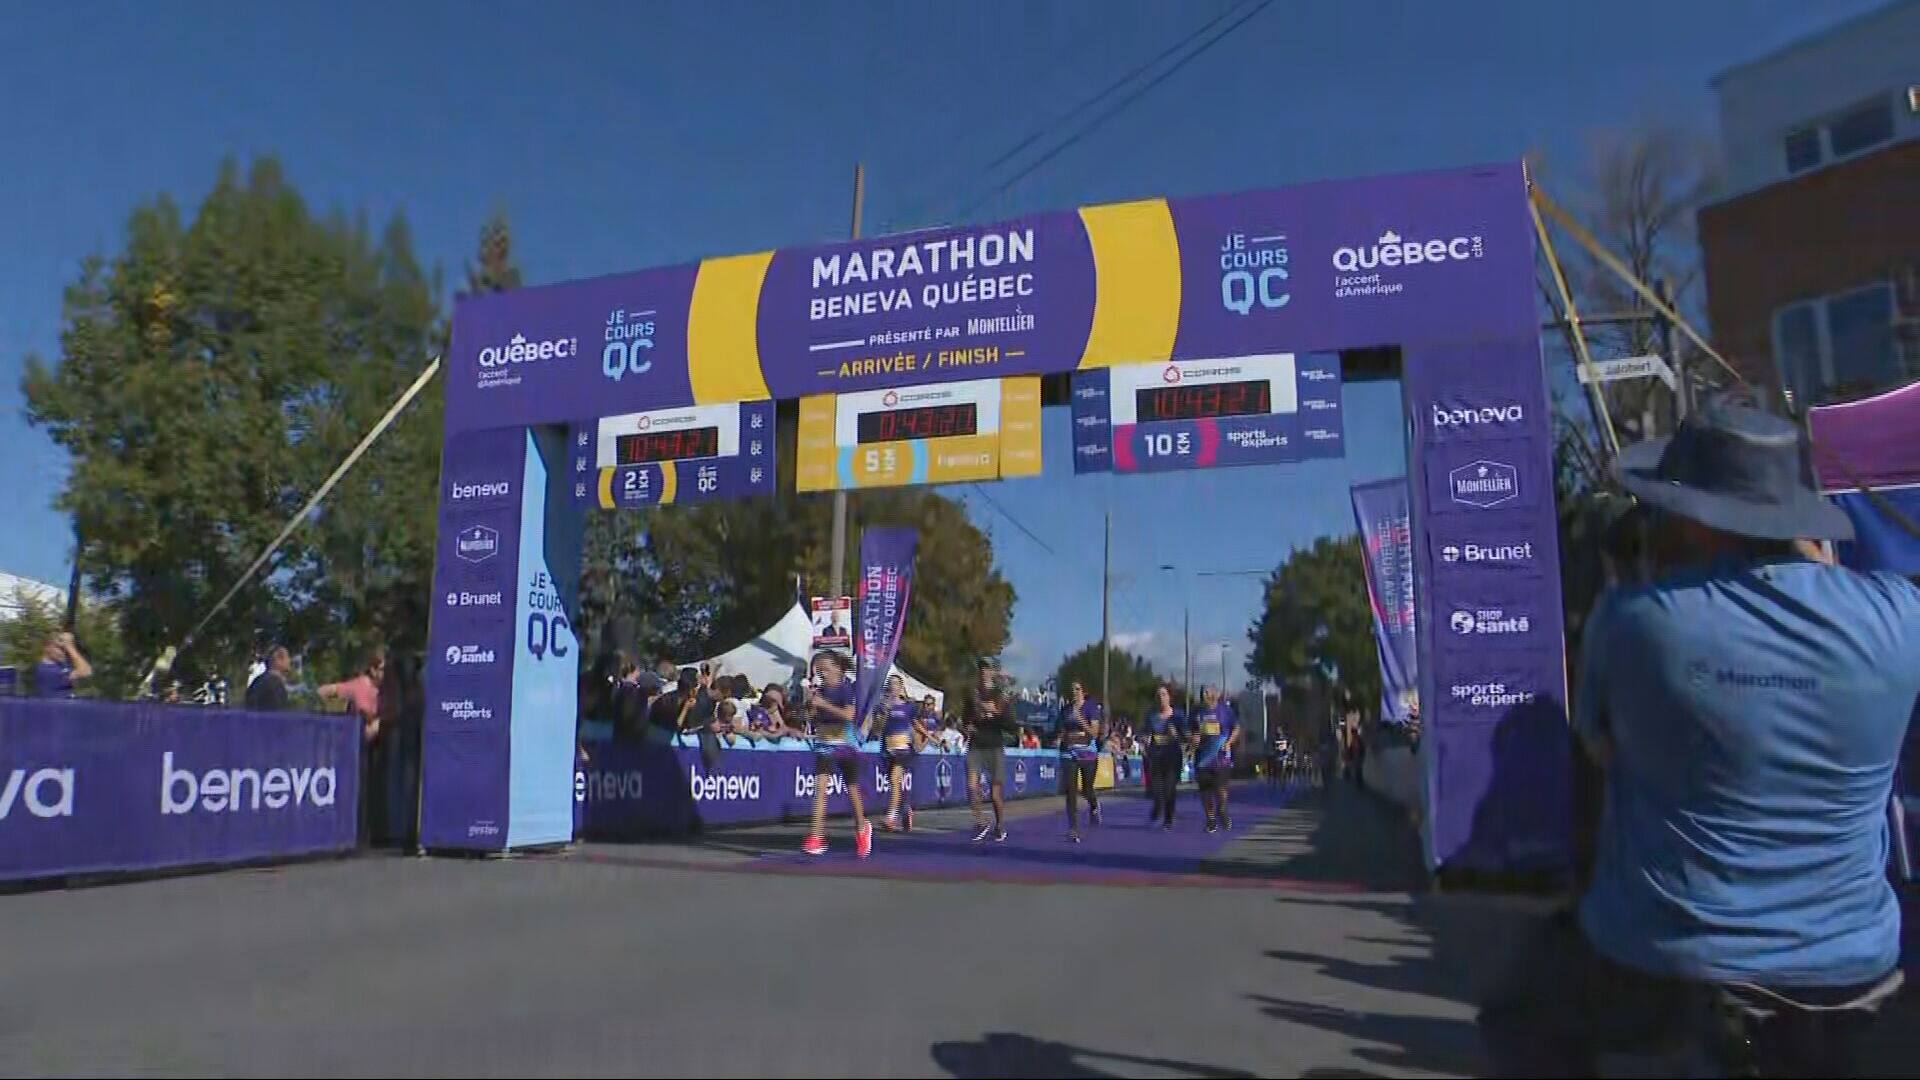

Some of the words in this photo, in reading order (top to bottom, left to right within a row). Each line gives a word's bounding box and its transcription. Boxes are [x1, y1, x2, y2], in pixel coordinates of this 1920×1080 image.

[1221, 234, 1245, 251] JE
[811, 229, 1035, 289] MARATHON
[1220, 248, 1288, 270] COURS
[809, 288, 913, 320] BENEVA
[922, 273, 1034, 309] QUÉBEC
[1221, 268, 1290, 315] QC
[605, 309, 625, 326] JE
[604, 321, 655, 342] COURS
[869, 326, 932, 347] PRÉSENTÉ
[935, 326, 960, 340] PAR
[967, 311, 1035, 336] MONTELLIER
[602, 338, 653, 382] QC
[838, 351, 917, 378] ARRIVÉE
[938, 346, 999, 368] FINISH
[1432, 404, 1523, 426] beneva
[1144, 433, 1173, 457] 10
[1177, 432, 1191, 455] KM
[1227, 429, 1267, 443] sports
[1240, 434, 1288, 448] experts
[866, 449, 880, 472] 5
[452, 481, 509, 499] beneva
[624, 470, 637, 490] 2
[1464, 543, 1532, 562] Brunet
[530, 573, 546, 588] JE
[460, 592, 502, 606] Brunet
[529, 590, 562, 612] COUR
[863, 565, 883, 670] MARATHON
[528, 612, 568, 661] QC
[1451, 683, 1505, 699] sports
[441, 699, 474, 712] sports
[452, 706, 492, 720] experts
[160, 752, 337, 815] beneva
[575, 771, 643, 802] eneva
[690, 764, 760, 801] beneva
